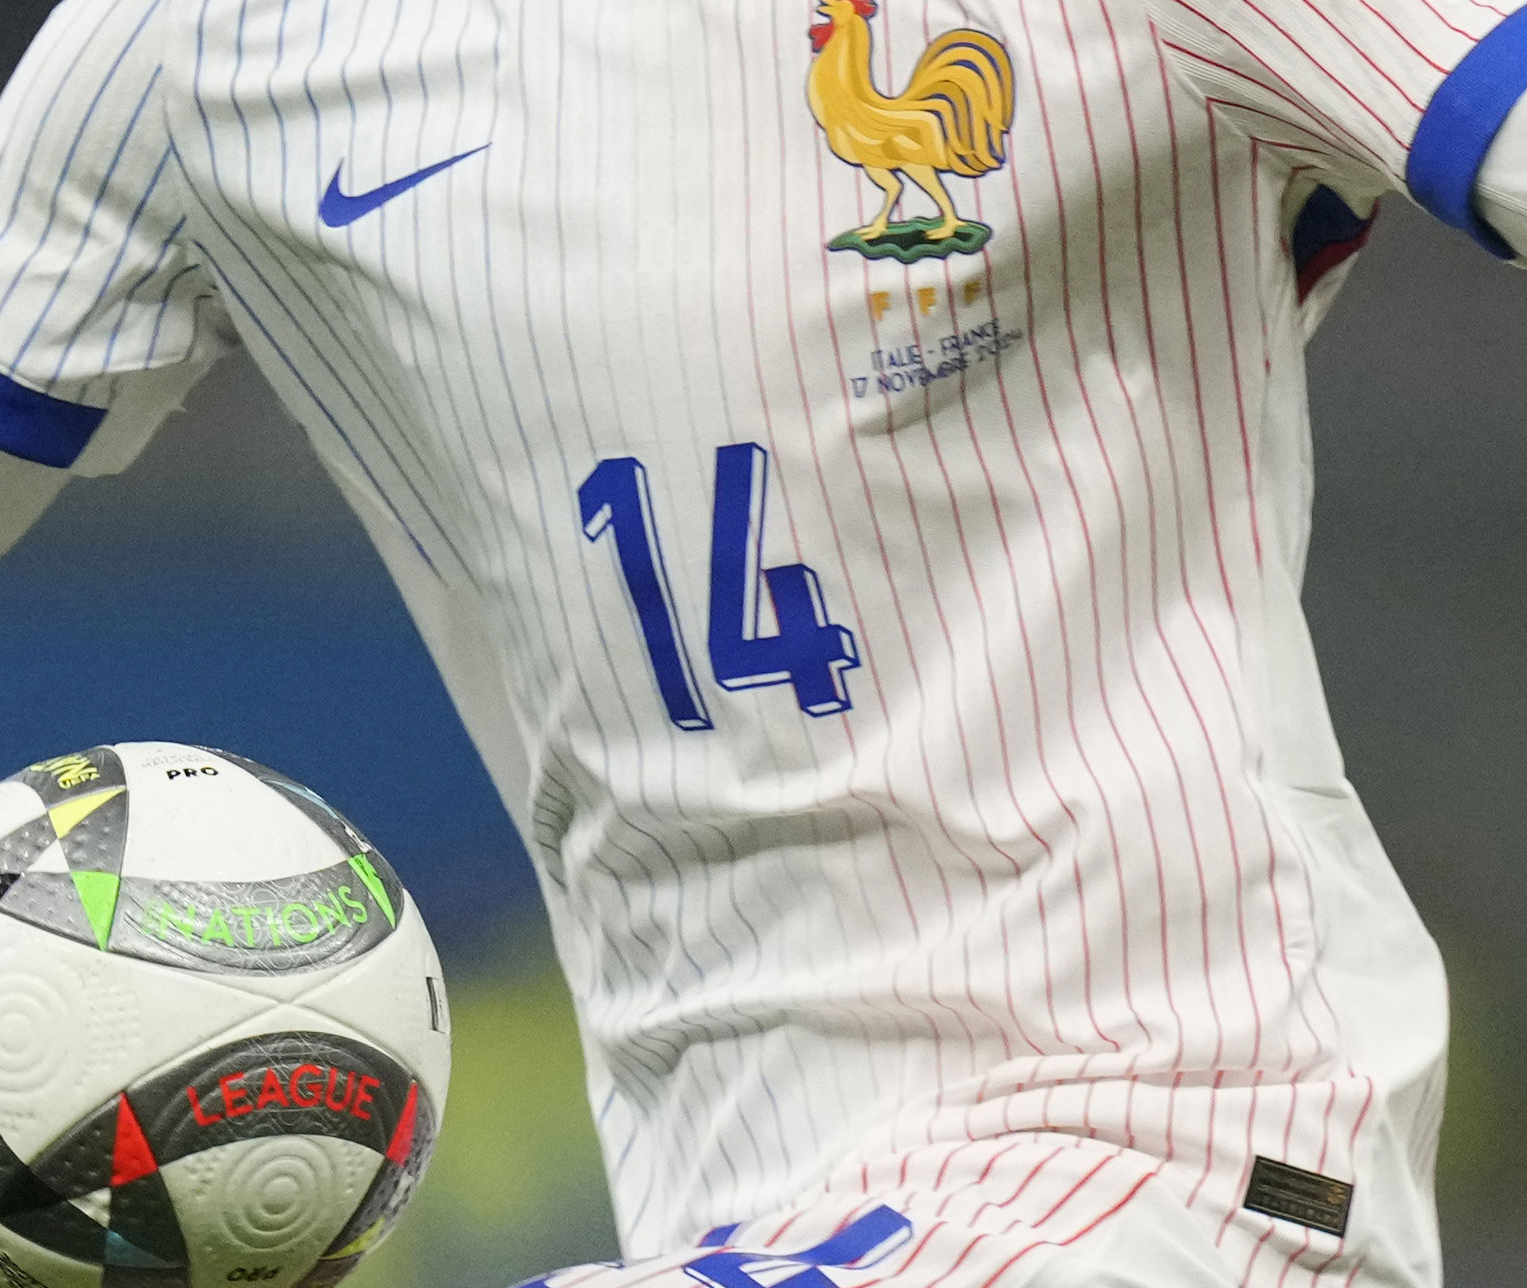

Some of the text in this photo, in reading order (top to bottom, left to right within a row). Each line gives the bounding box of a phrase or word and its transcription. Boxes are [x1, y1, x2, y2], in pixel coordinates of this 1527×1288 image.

[577, 441, 862, 731] 14
[166, 766, 219, 780] PRO
[154, 885, 368, 947] NATIONS
[186, 1063, 381, 1127] LEAGUE
